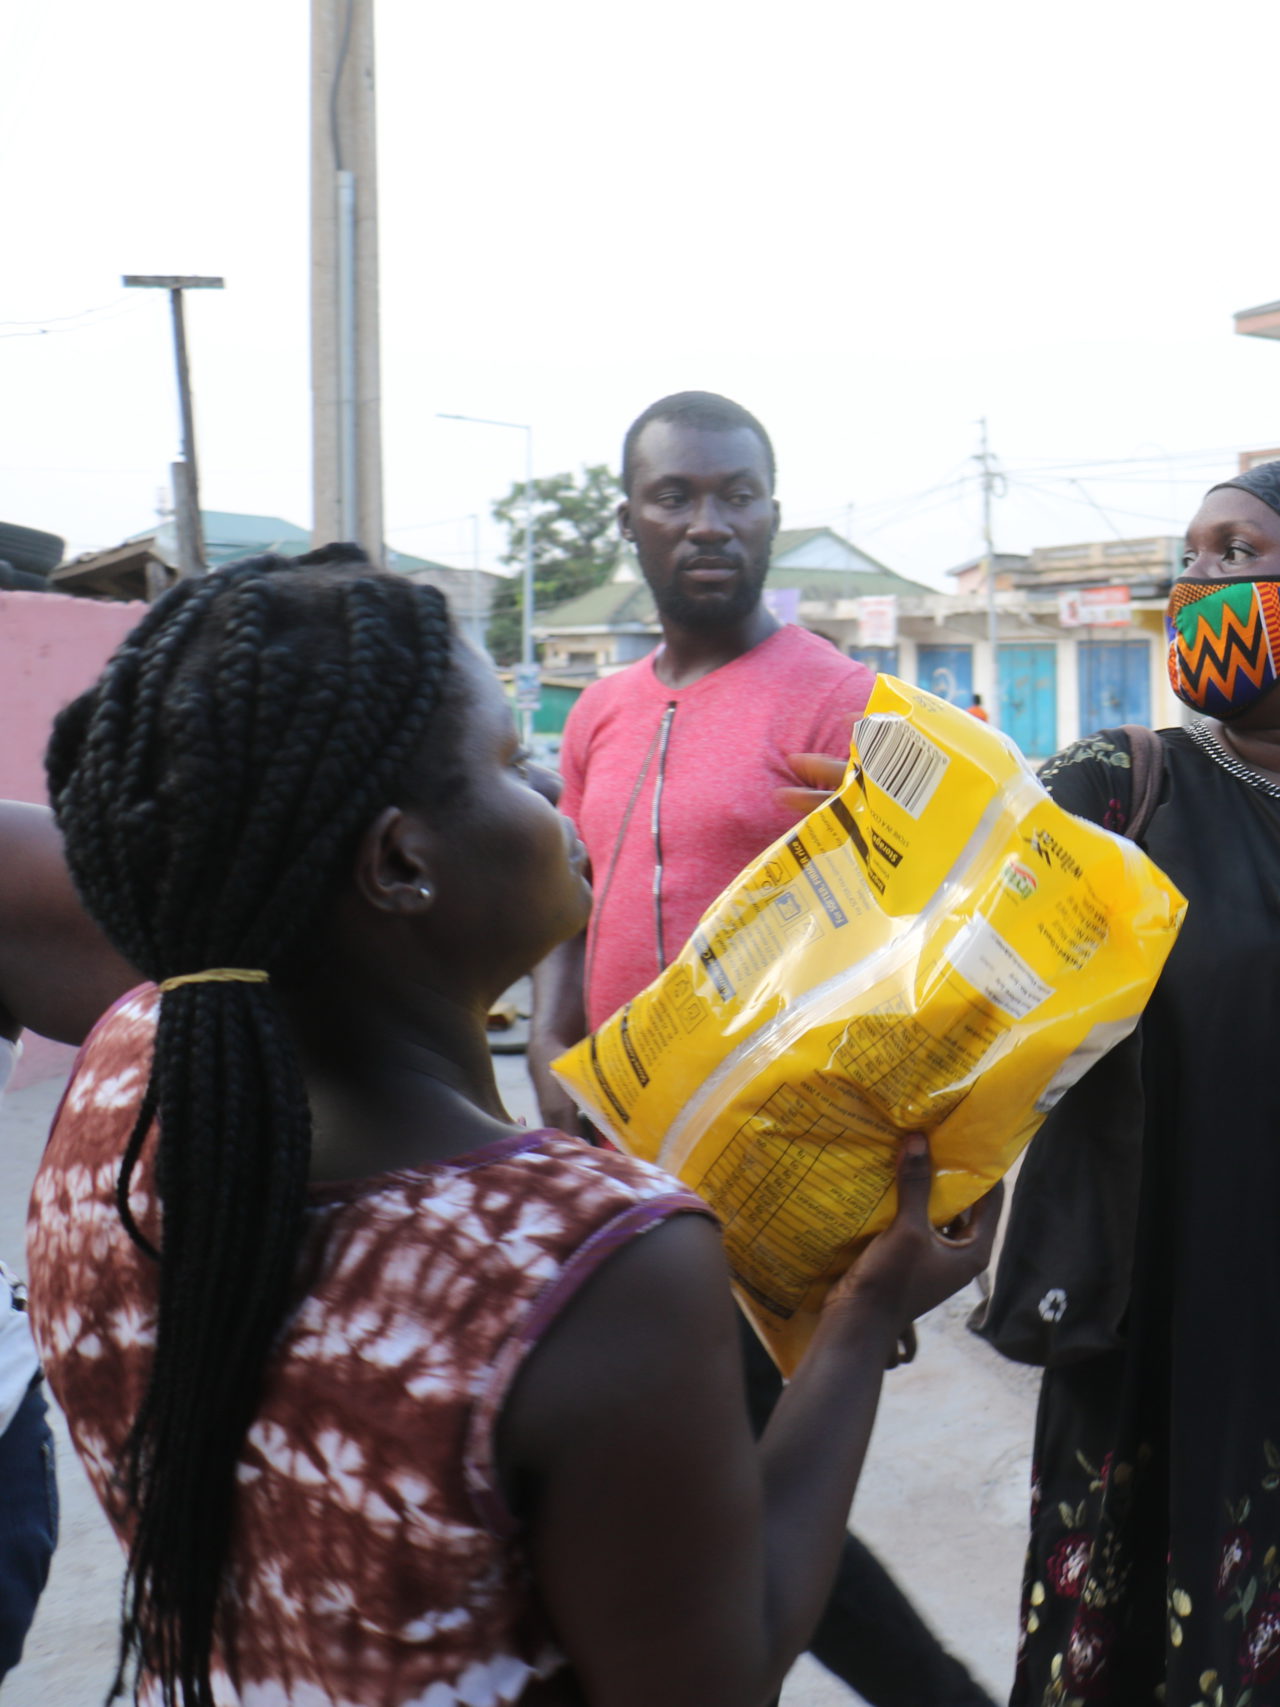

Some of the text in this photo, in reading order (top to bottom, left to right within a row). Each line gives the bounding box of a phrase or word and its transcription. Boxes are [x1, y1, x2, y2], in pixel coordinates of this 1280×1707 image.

[789, 838, 806, 859] rice
[869, 832, 900, 863] Storage
[1034, 828, 1086, 881] wilmar
